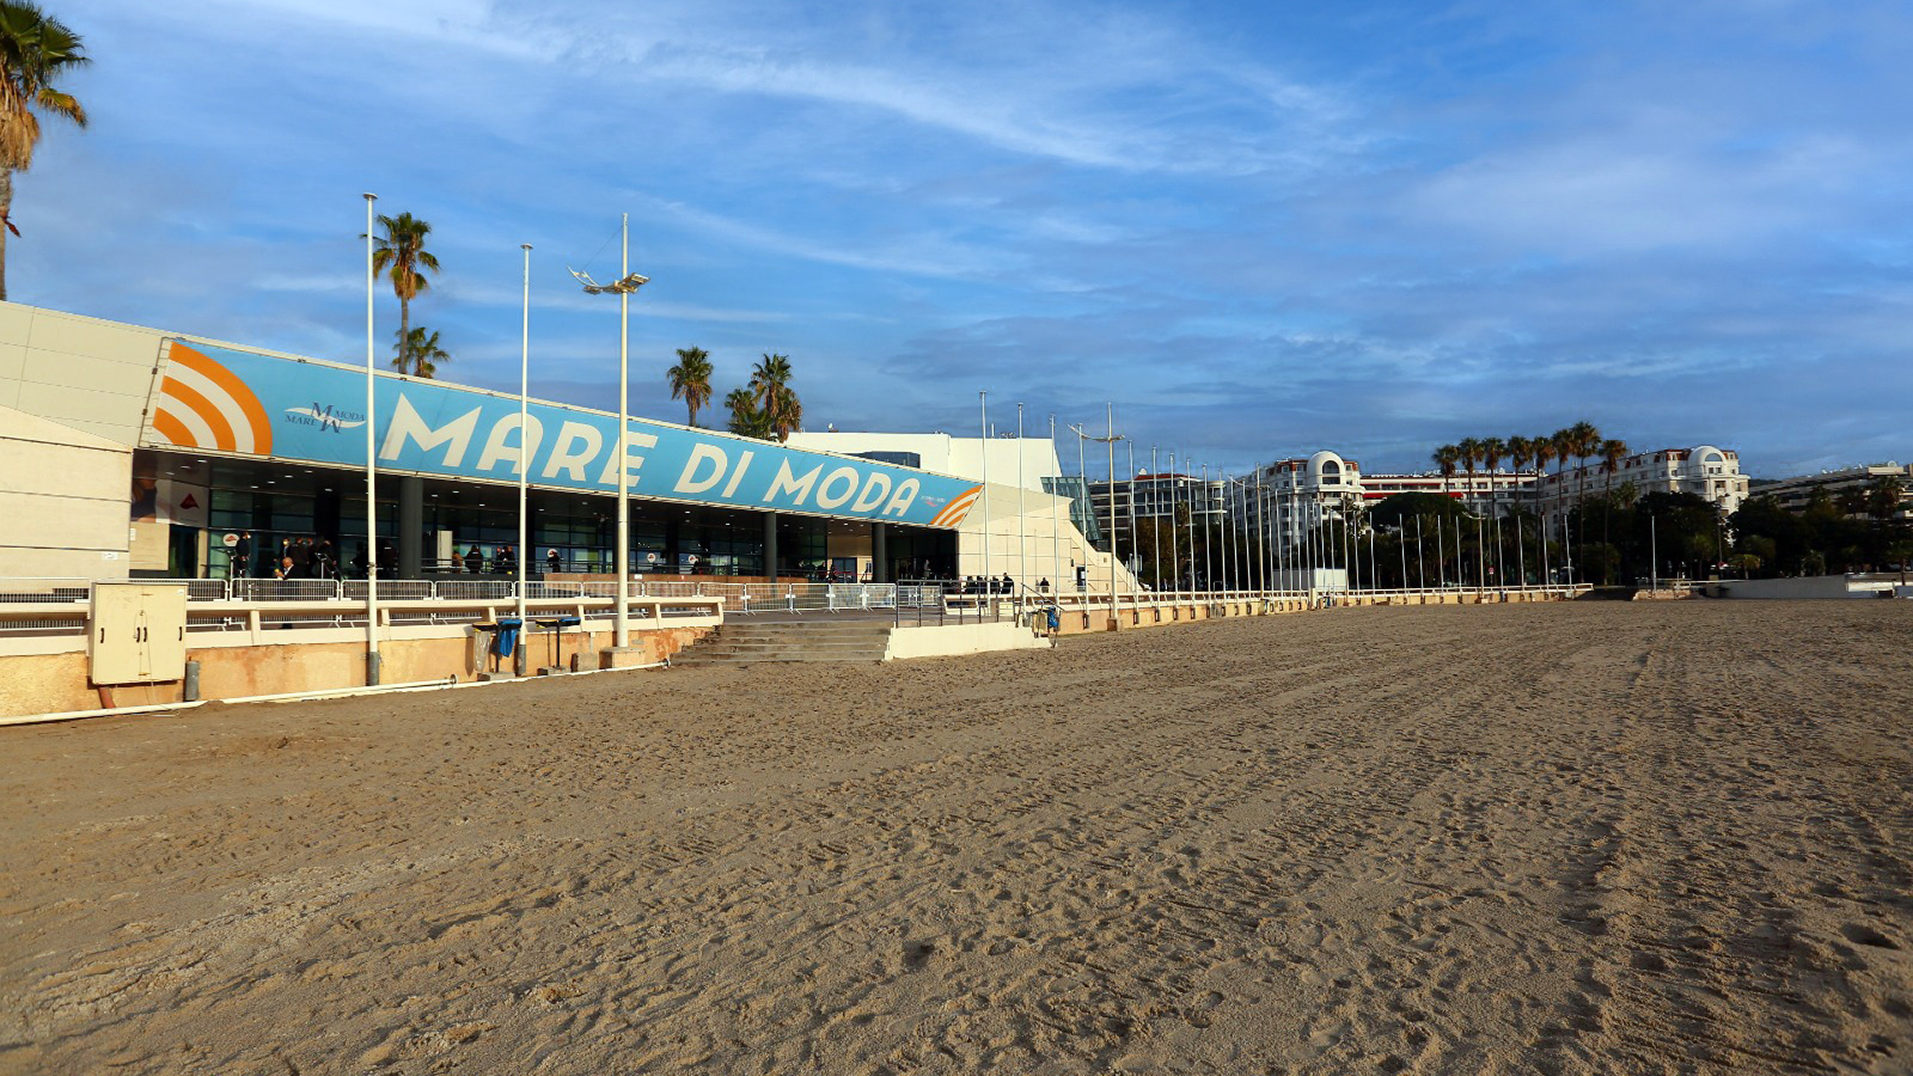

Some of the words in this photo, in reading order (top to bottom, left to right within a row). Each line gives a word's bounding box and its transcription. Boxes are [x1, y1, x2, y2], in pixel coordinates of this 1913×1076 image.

[285, 415, 318, 426] MARE
[335, 411, 365, 421] MODA
[378, 392, 658, 487] MARE
[673, 443, 754, 498] DI
[762, 457, 920, 517] MODA
